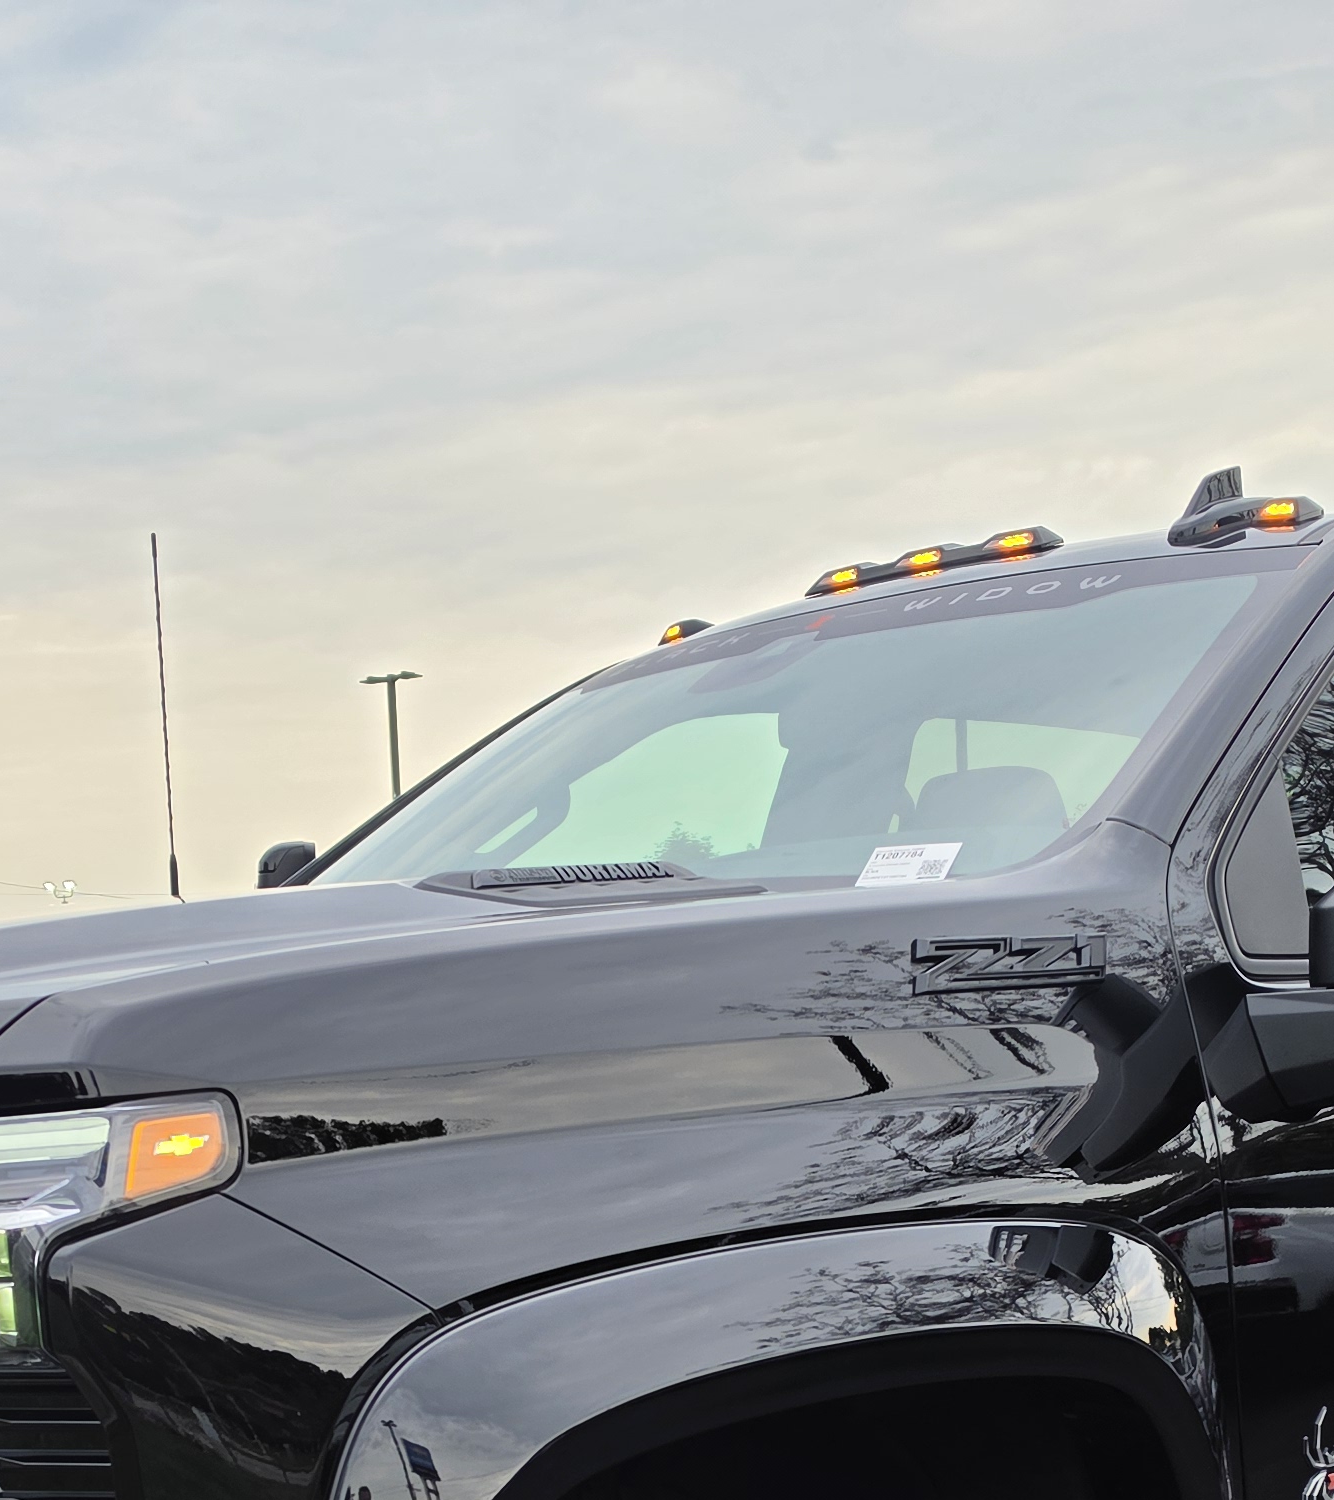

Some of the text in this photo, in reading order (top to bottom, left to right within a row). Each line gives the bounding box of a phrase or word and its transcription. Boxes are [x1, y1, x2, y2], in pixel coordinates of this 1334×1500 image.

[903, 574, 1122, 612] WIDOW
[552, 861, 674, 883] DURAMAX
[911, 932, 1107, 996] Z71
